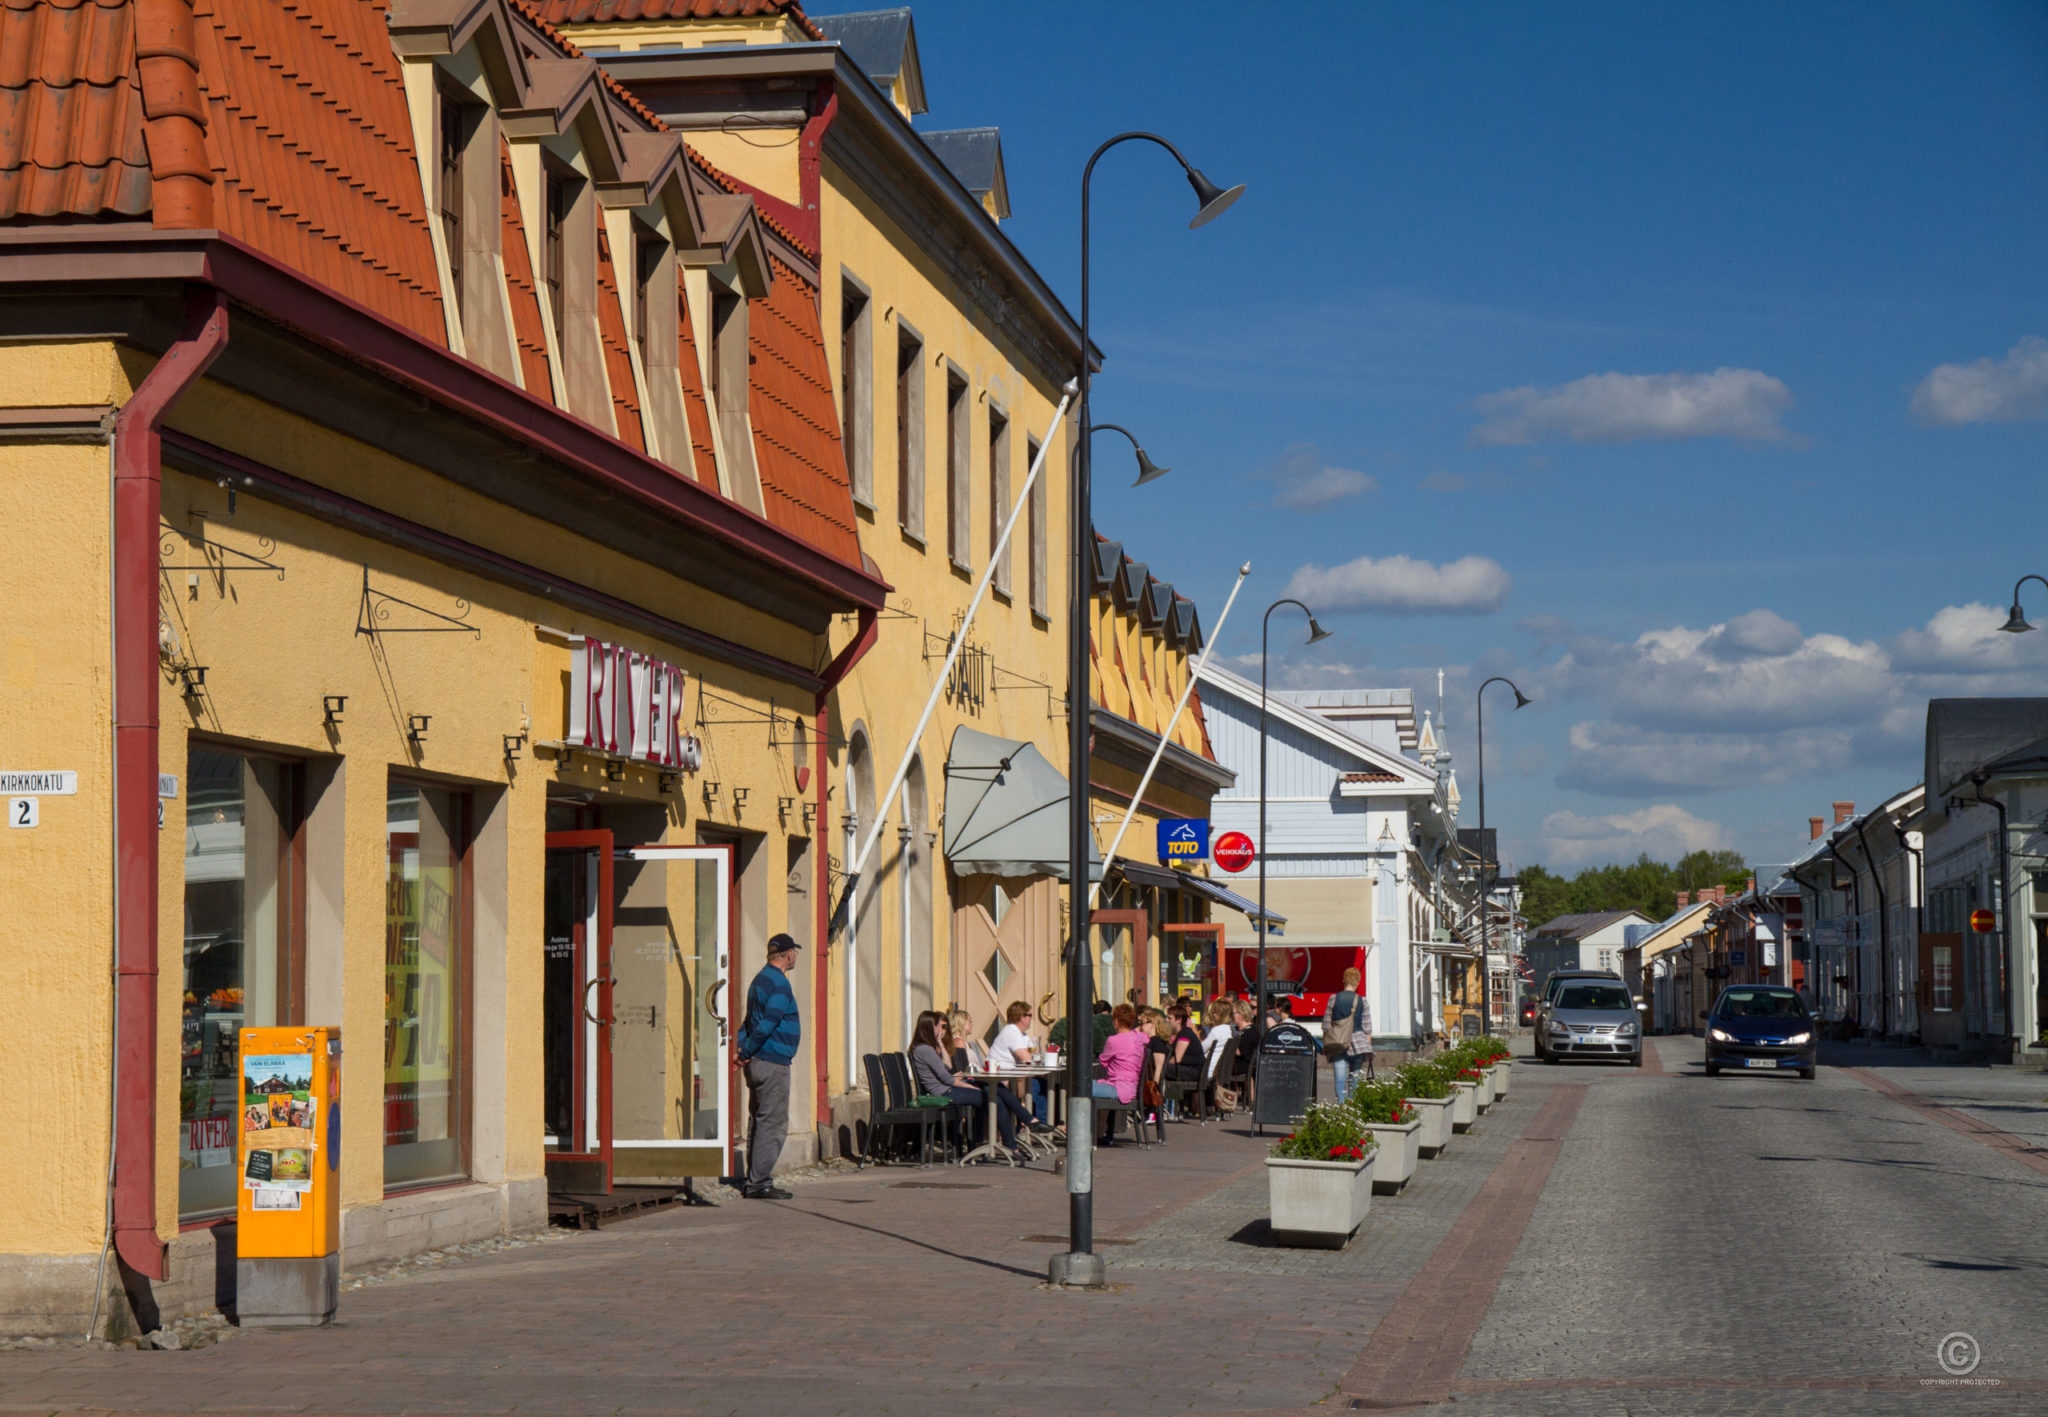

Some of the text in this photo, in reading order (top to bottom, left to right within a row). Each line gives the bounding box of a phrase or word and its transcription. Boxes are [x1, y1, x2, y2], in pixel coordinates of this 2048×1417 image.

[570, 635, 683, 767] RIVER
[0, 774, 63, 792] KIRKKOKATU
[18, 801, 31, 825] 2
[1167, 841, 1199, 854] TOTO
[1216, 848, 1253, 856] VEIKKAUS
[190, 1116, 230, 1151] RIVER
